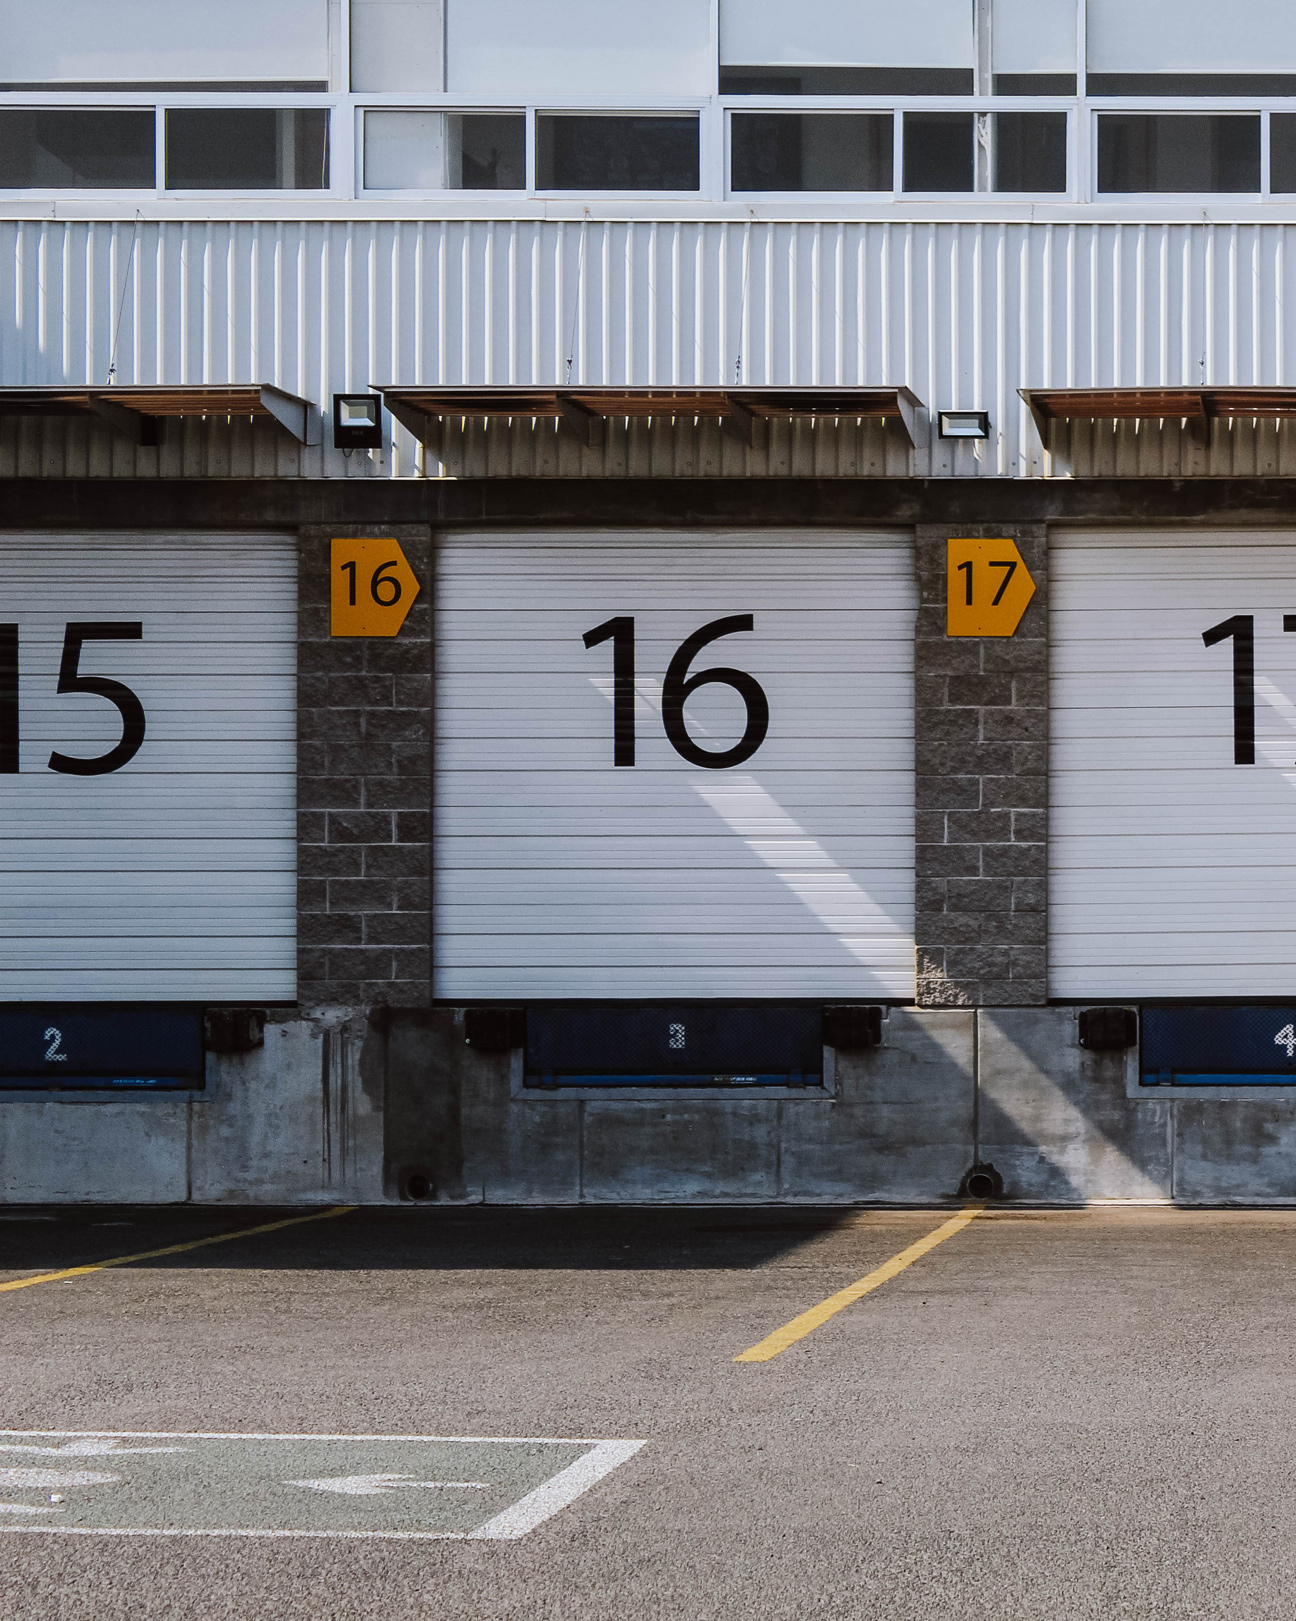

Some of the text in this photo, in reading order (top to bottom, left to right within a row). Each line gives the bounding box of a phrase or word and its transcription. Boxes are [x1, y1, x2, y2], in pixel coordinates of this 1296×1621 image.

[340, 560, 403, 607] 16
[957, 560, 1018, 607] 17
[582, 613, 769, 769] 16
[44, 1027, 67, 1061] 2
[669, 1023, 685, 1049] 3
